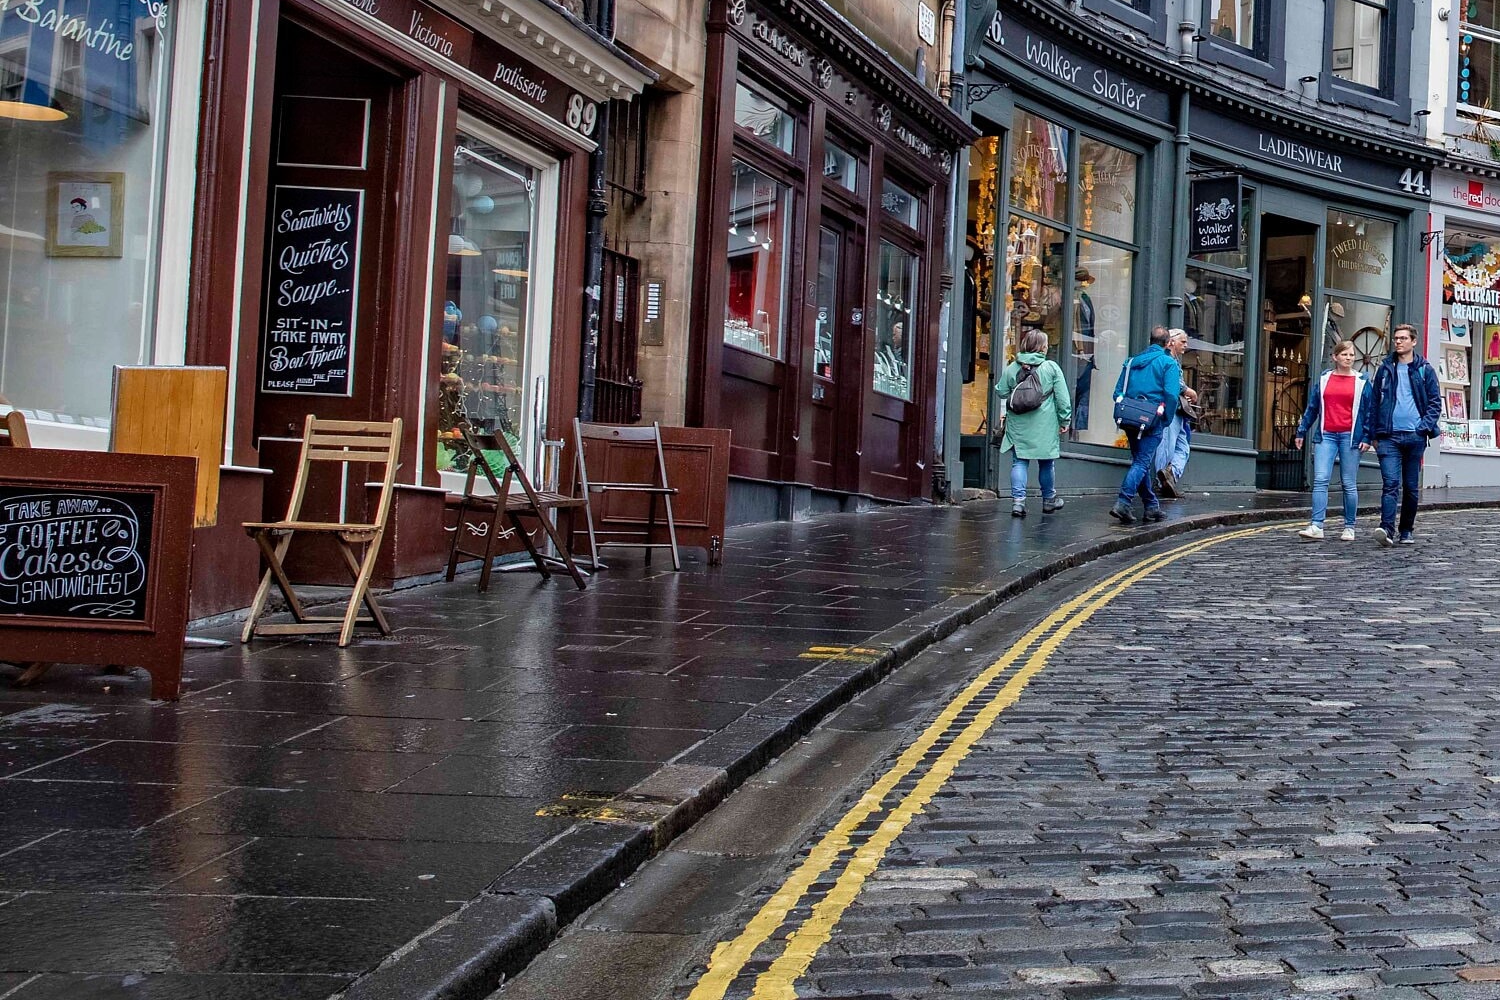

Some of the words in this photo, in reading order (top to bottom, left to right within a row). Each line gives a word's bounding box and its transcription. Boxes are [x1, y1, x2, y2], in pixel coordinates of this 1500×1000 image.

[408, 9, 454, 58] Victoria
[493, 62, 548, 104] patisserie
[566, 93, 597, 136] 89
[984, 9, 1005, 46] 6.
[1026, 35, 1082, 84] Walker
[1092, 68, 1147, 111] Slater
[1258, 133, 1343, 173] LADIESWEAR
[1398, 167, 1431, 196] 44.
[1452, 185, 1468, 200] the
[1468, 192, 1483, 204] red
[279, 238, 349, 275] Quiches
[1331, 238, 1357, 258] TWEED
[1454, 283, 1500, 306] CELEBRATE
[270, 329, 307, 343] TAKE
[310, 331, 346, 345] AWAY
[269, 345, 304, 372] Bon
[267, 380, 295, 388] PLEASE
[4, 501, 52, 521] TAKE
[56, 499, 112, 515] AWAY...
[17, 519, 99, 553] COFFEE
[0, 539, 91, 581] Cakes
